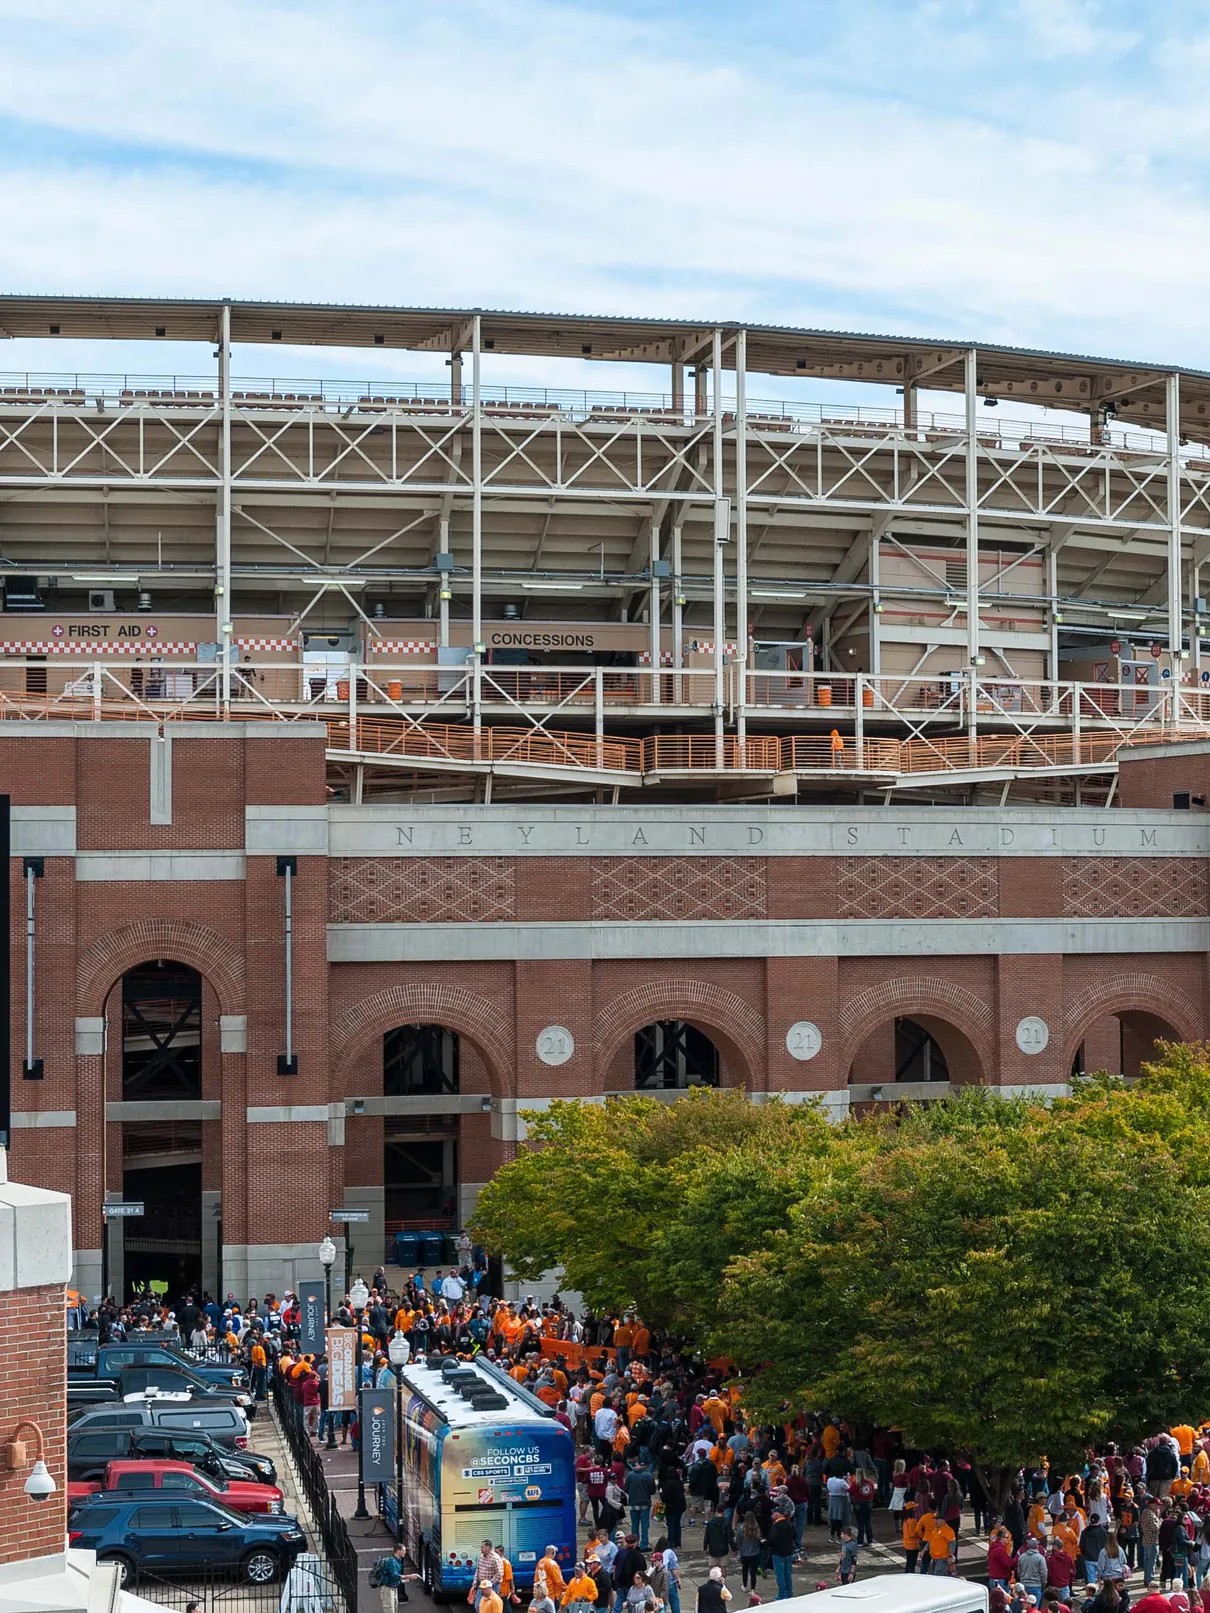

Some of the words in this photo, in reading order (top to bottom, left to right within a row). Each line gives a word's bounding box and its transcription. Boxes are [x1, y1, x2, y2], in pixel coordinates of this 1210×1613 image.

[68, 625, 110, 637] FIRST
[117, 625, 141, 637] AID
[491, 633, 594, 647] CONCESSIONS
[395, 826, 764, 845] NEYLAND
[847, 827, 1158, 847] STADIUM
[792, 1032, 813, 1049] 21
[1023, 1027, 1042, 1044] 21
[542, 1036, 567, 1054] 21
[307, 1303, 316, 1342] JOURNEY
[371, 1416, 381, 1466] JOURNEY
[487, 1447, 526, 1457] FOLLOW
[527, 1446, 540, 1454] US
[470, 1454, 540, 1467] @SECONCBS
